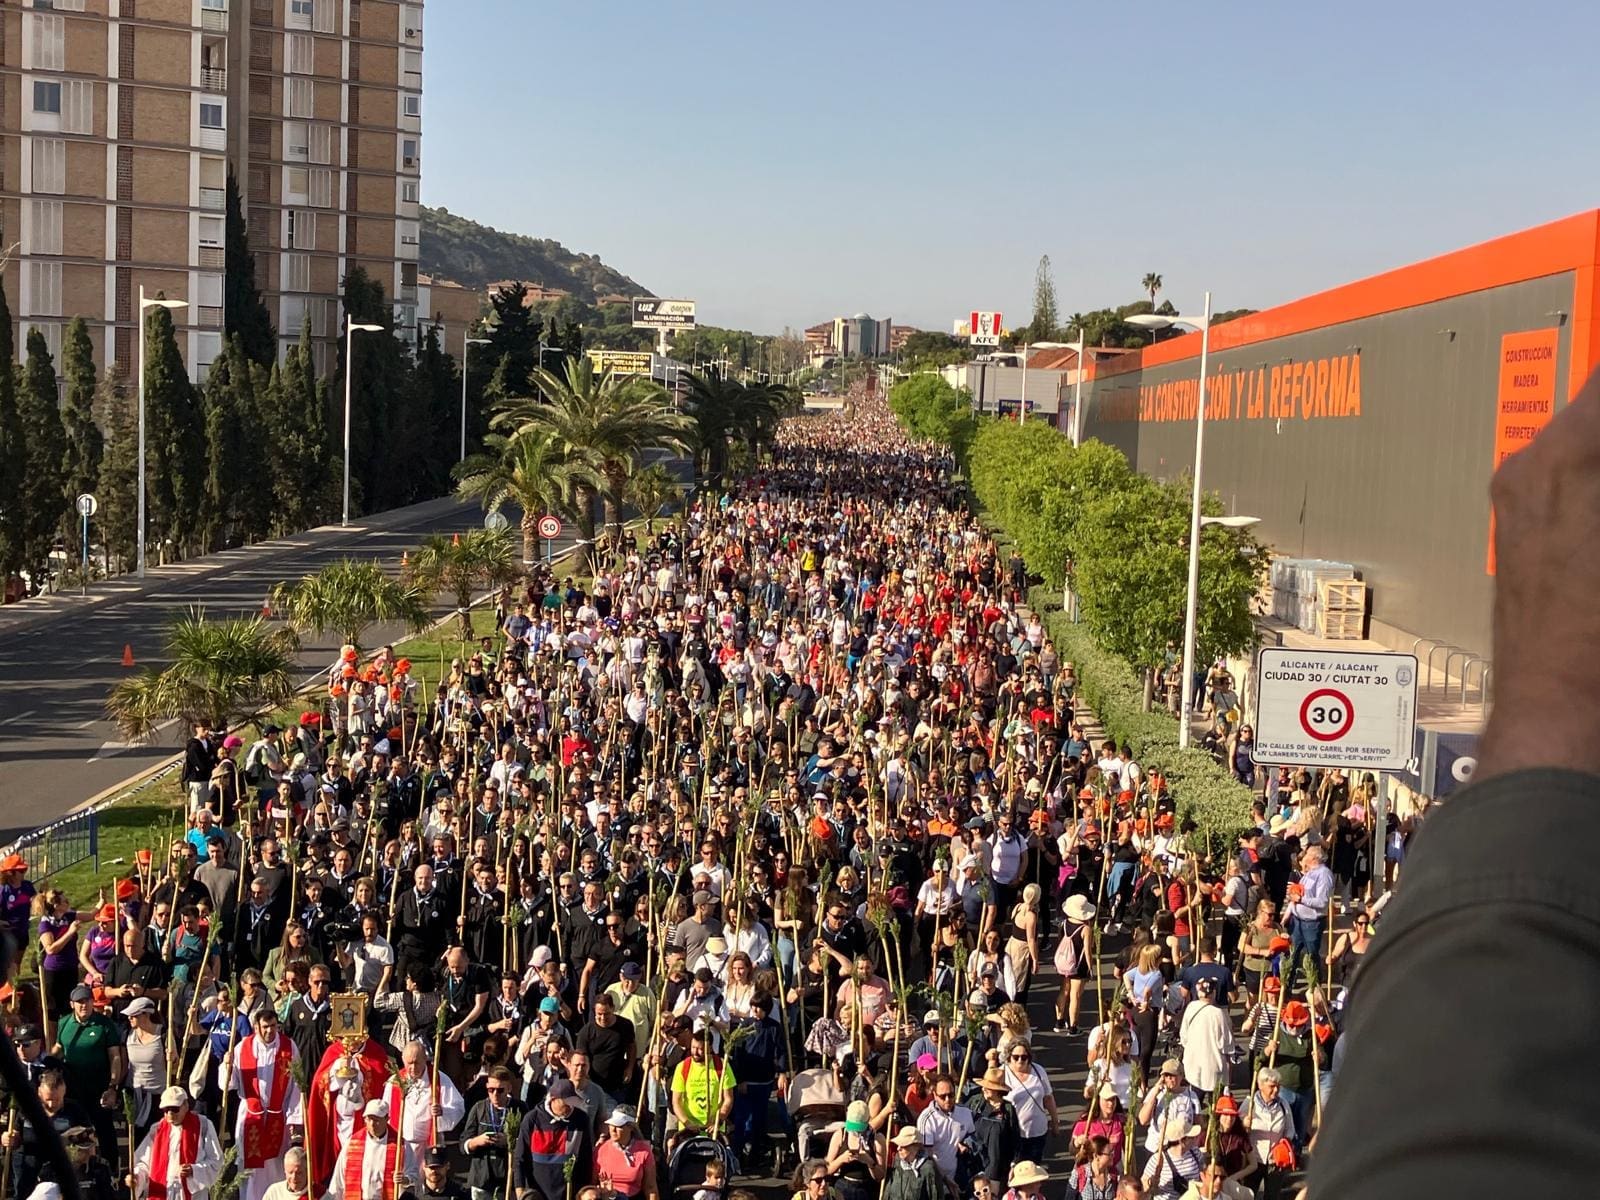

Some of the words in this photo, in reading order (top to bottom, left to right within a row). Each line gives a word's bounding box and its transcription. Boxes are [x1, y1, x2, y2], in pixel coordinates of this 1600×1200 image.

[1236, 371, 1246, 419] Y
[1247, 369, 1265, 419] LA
[1269, 354, 1360, 420] REFORMA
[1513, 374, 1539, 388] MADERA
[1502, 400, 1549, 413] HERRAMIENTAS
[543, 523, 556, 531] 50
[1280, 661, 1326, 670] ALICANTE
[1335, 663, 1379, 672] ALACANT
[1265, 671, 1305, 682] CIUDAD
[1308, 673, 1322, 683] 30
[1333, 675, 1372, 685] CIUTAT
[1374, 676, 1388, 686] 30
[1312, 707, 1343, 724] 30
[1361, 747, 1391, 755] SENTIDO
